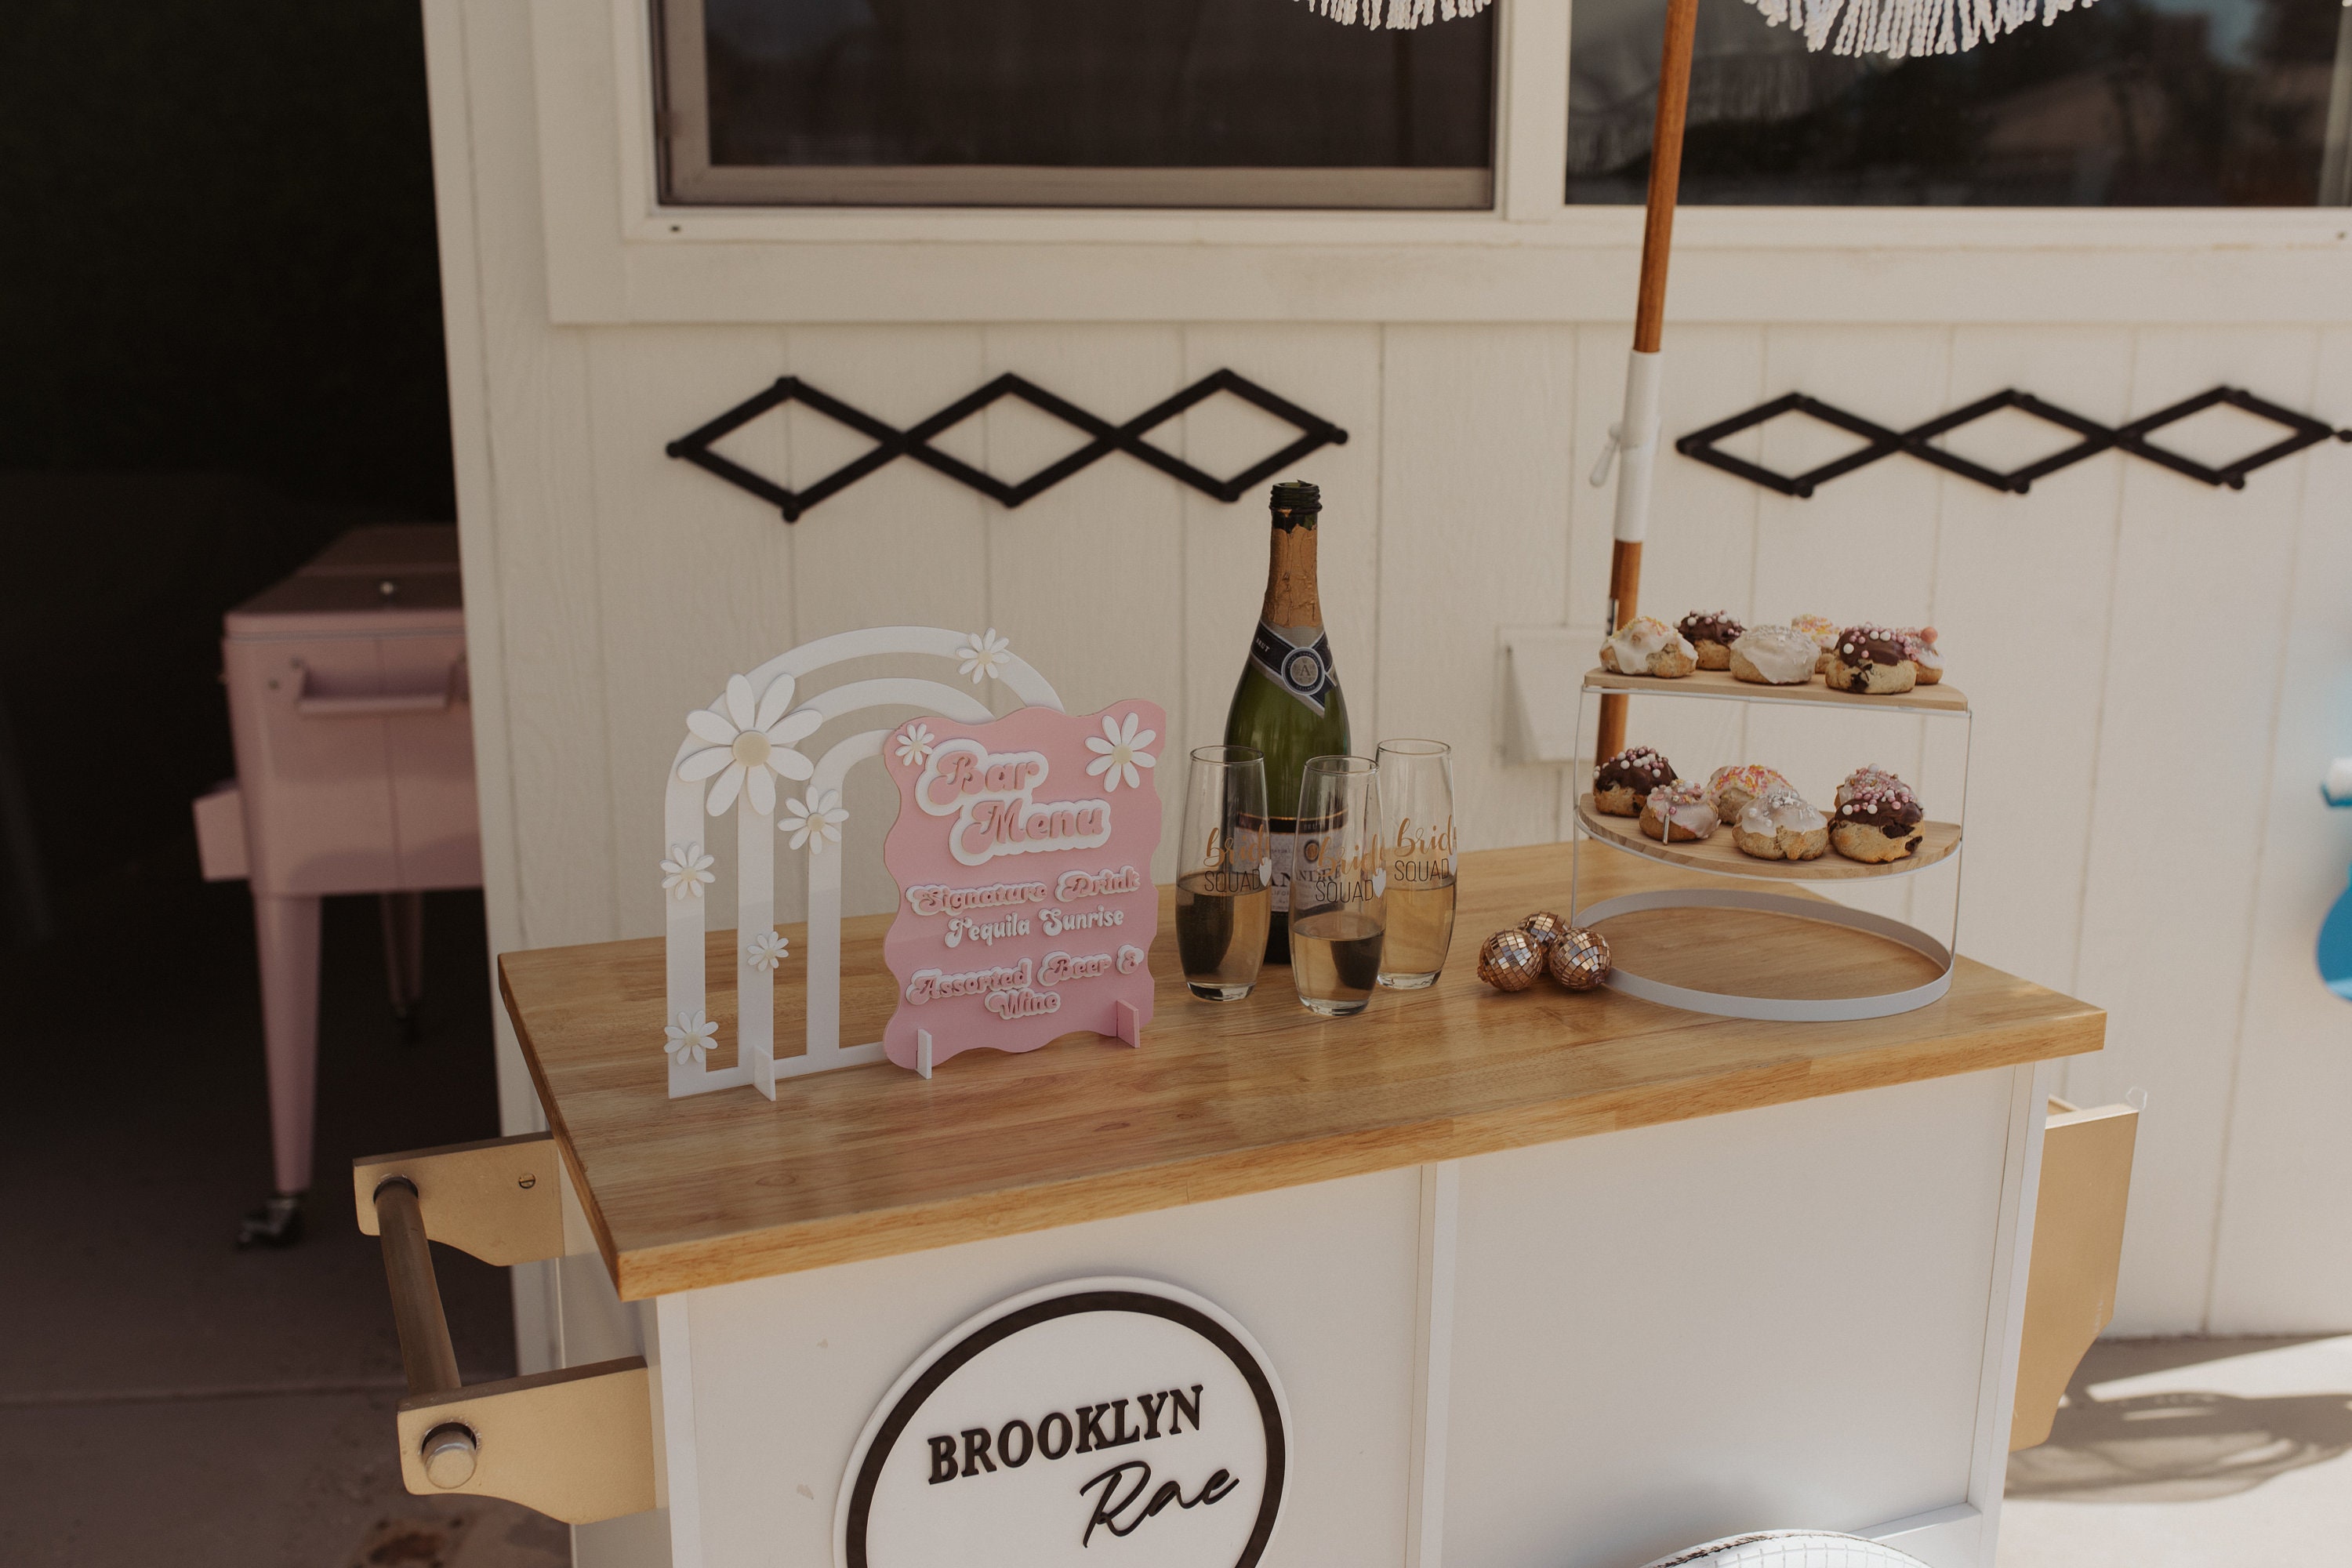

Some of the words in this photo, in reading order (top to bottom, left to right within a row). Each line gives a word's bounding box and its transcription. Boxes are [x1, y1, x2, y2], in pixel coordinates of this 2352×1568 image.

[1256, 637, 1271, 652] BRUT
[927, 750, 1040, 806] Bar
[960, 797, 1105, 855] Menu
[911, 883, 1048, 913] Signature
[1060, 867, 1140, 900] Drink
[1204, 869, 1261, 893] SQUAD
[1315, 879, 1374, 903] SQUAD
[1394, 858, 1450, 883] SQUAD
[944, 912, 1030, 948] Tequila
[1038, 904, 1124, 936] Sunrise
[909, 962, 1031, 1005] Assorted
[1042, 954, 1111, 984] Beer
[988, 987, 1059, 1018] Wine
[927, 1385, 1203, 1485] BROOKLYN
[1079, 1460, 1240, 1548] Rae
